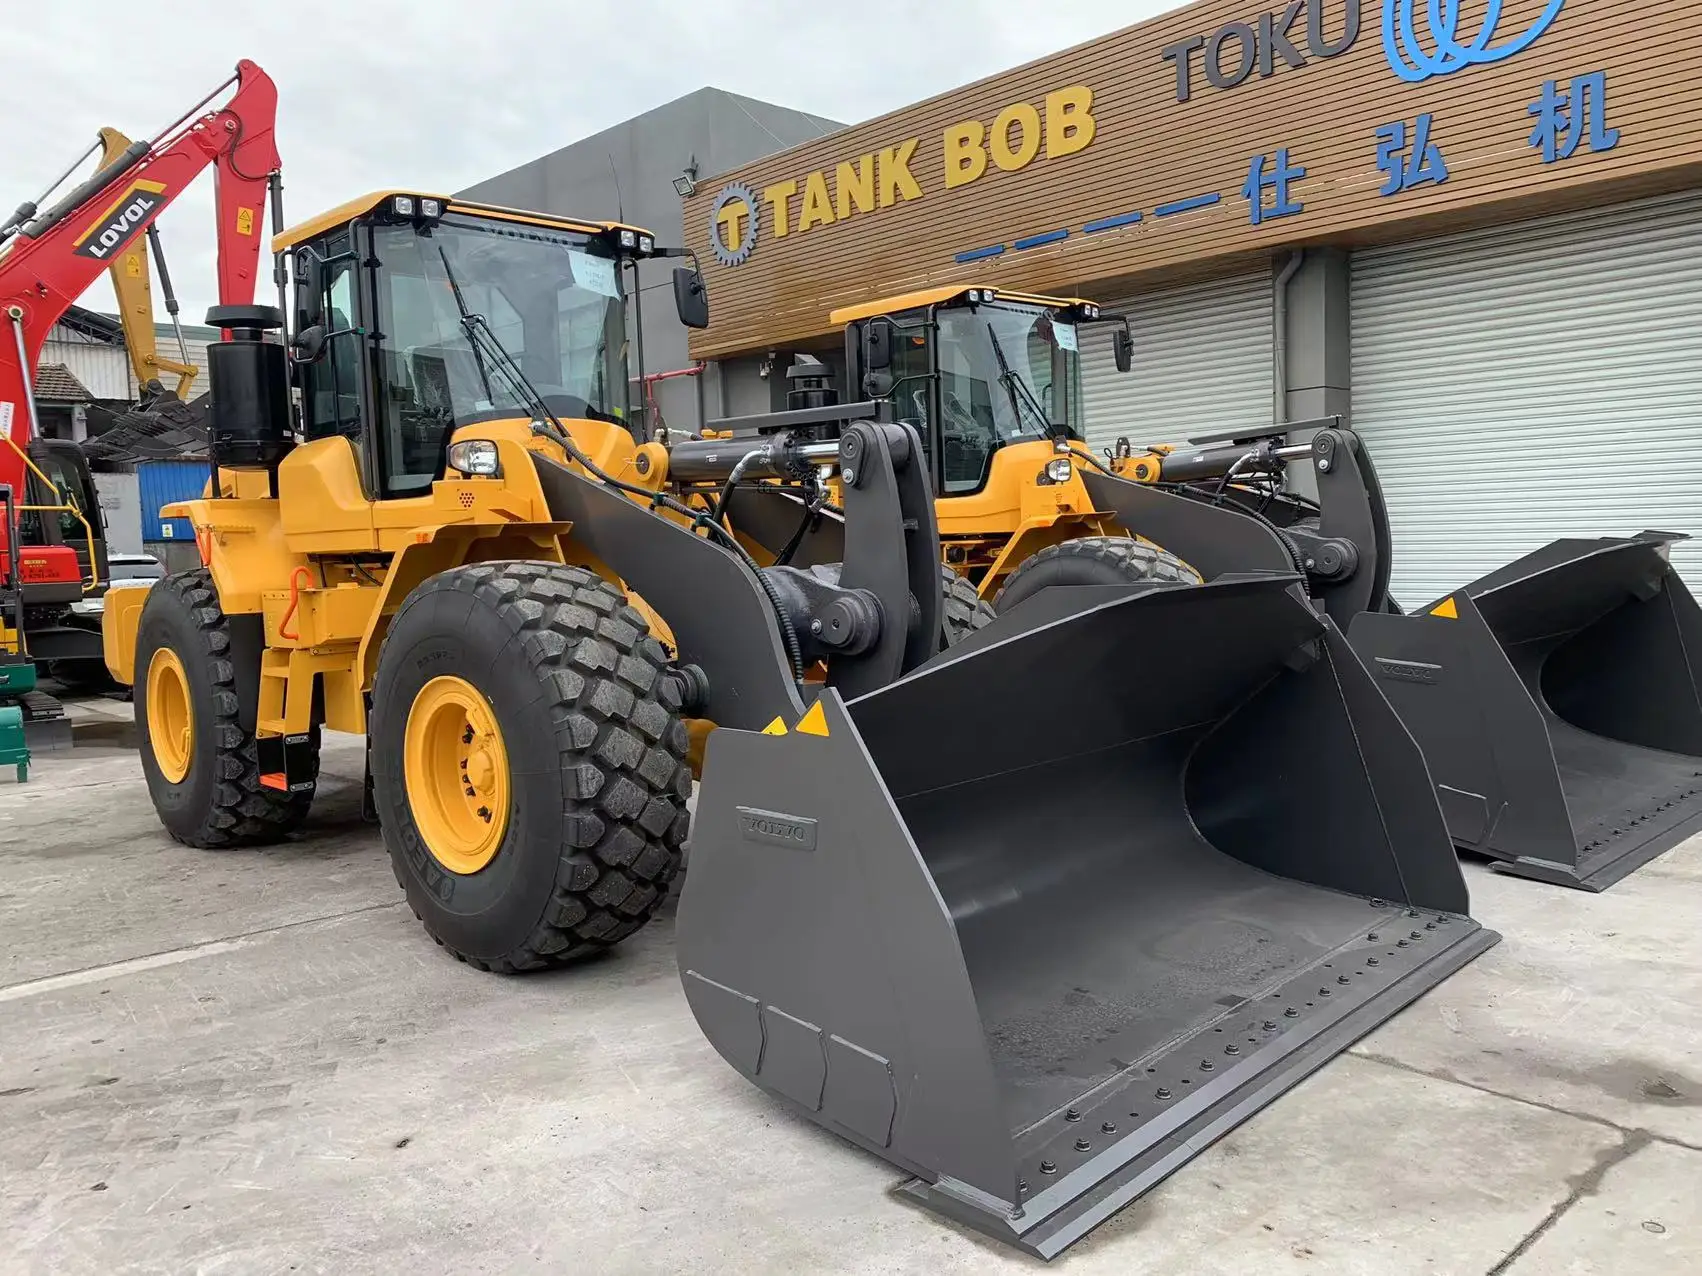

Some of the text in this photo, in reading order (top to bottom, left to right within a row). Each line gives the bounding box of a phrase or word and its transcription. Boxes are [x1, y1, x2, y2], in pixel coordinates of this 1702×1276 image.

[1162, 0, 1361, 102] TOKU
[764, 138, 926, 239] TANK
[943, 85, 1098, 190] BOB
[88, 197, 155, 258] LOVOL
